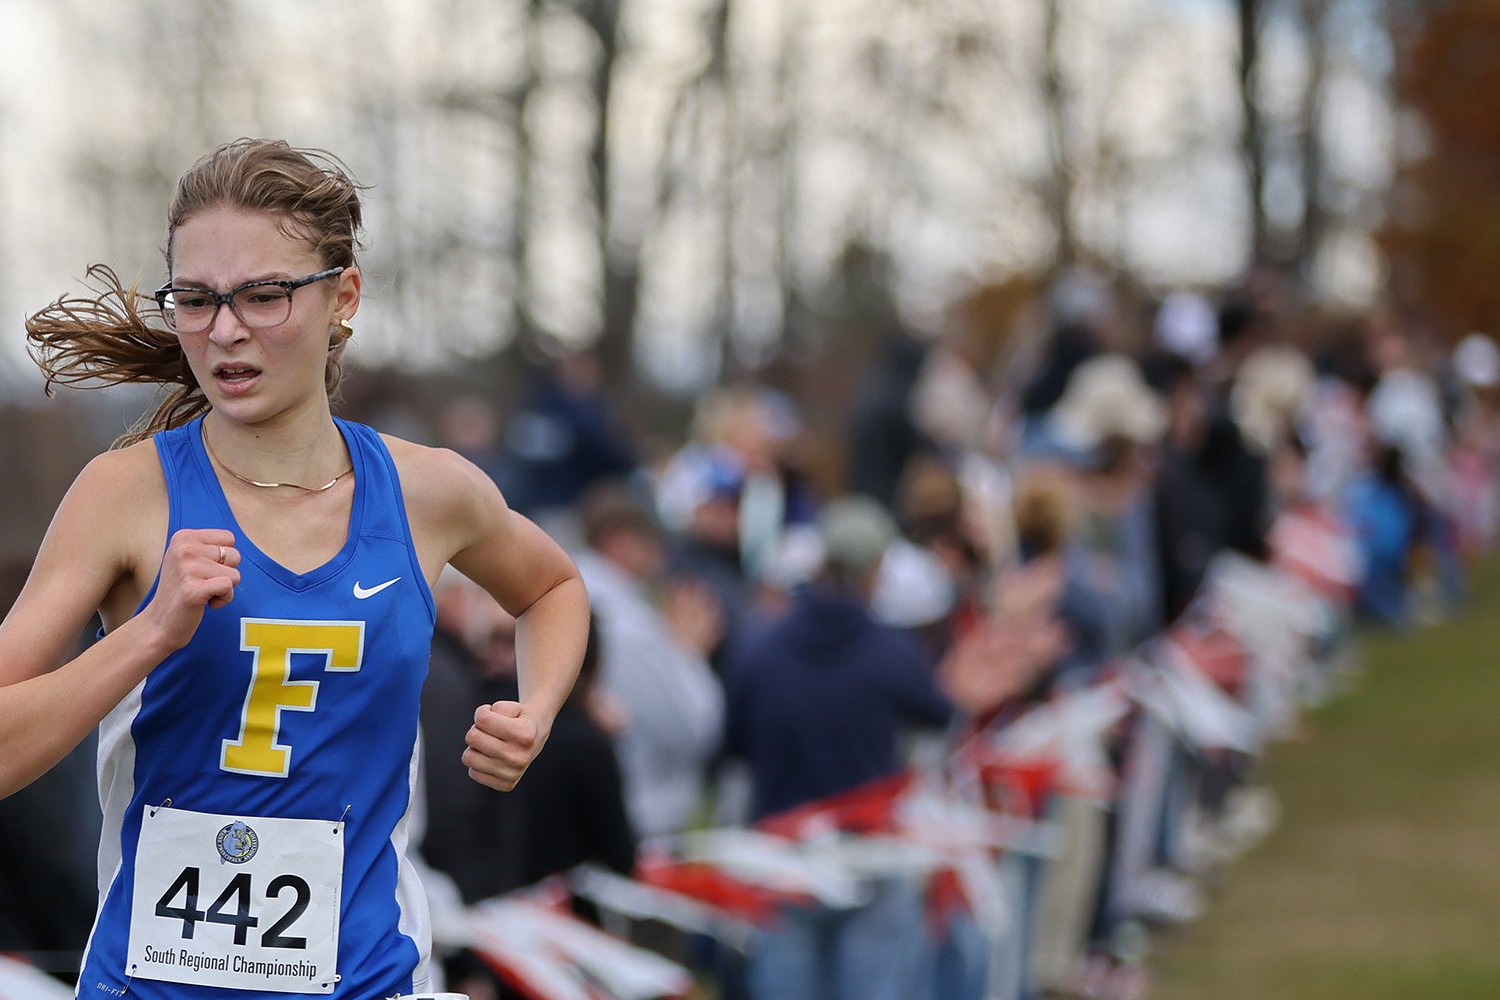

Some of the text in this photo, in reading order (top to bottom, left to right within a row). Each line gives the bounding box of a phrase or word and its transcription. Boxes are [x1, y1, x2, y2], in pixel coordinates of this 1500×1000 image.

[220, 617, 365, 778] F
[155, 866, 311, 949] 442
[144, 944, 317, 981] South Regional Championship
